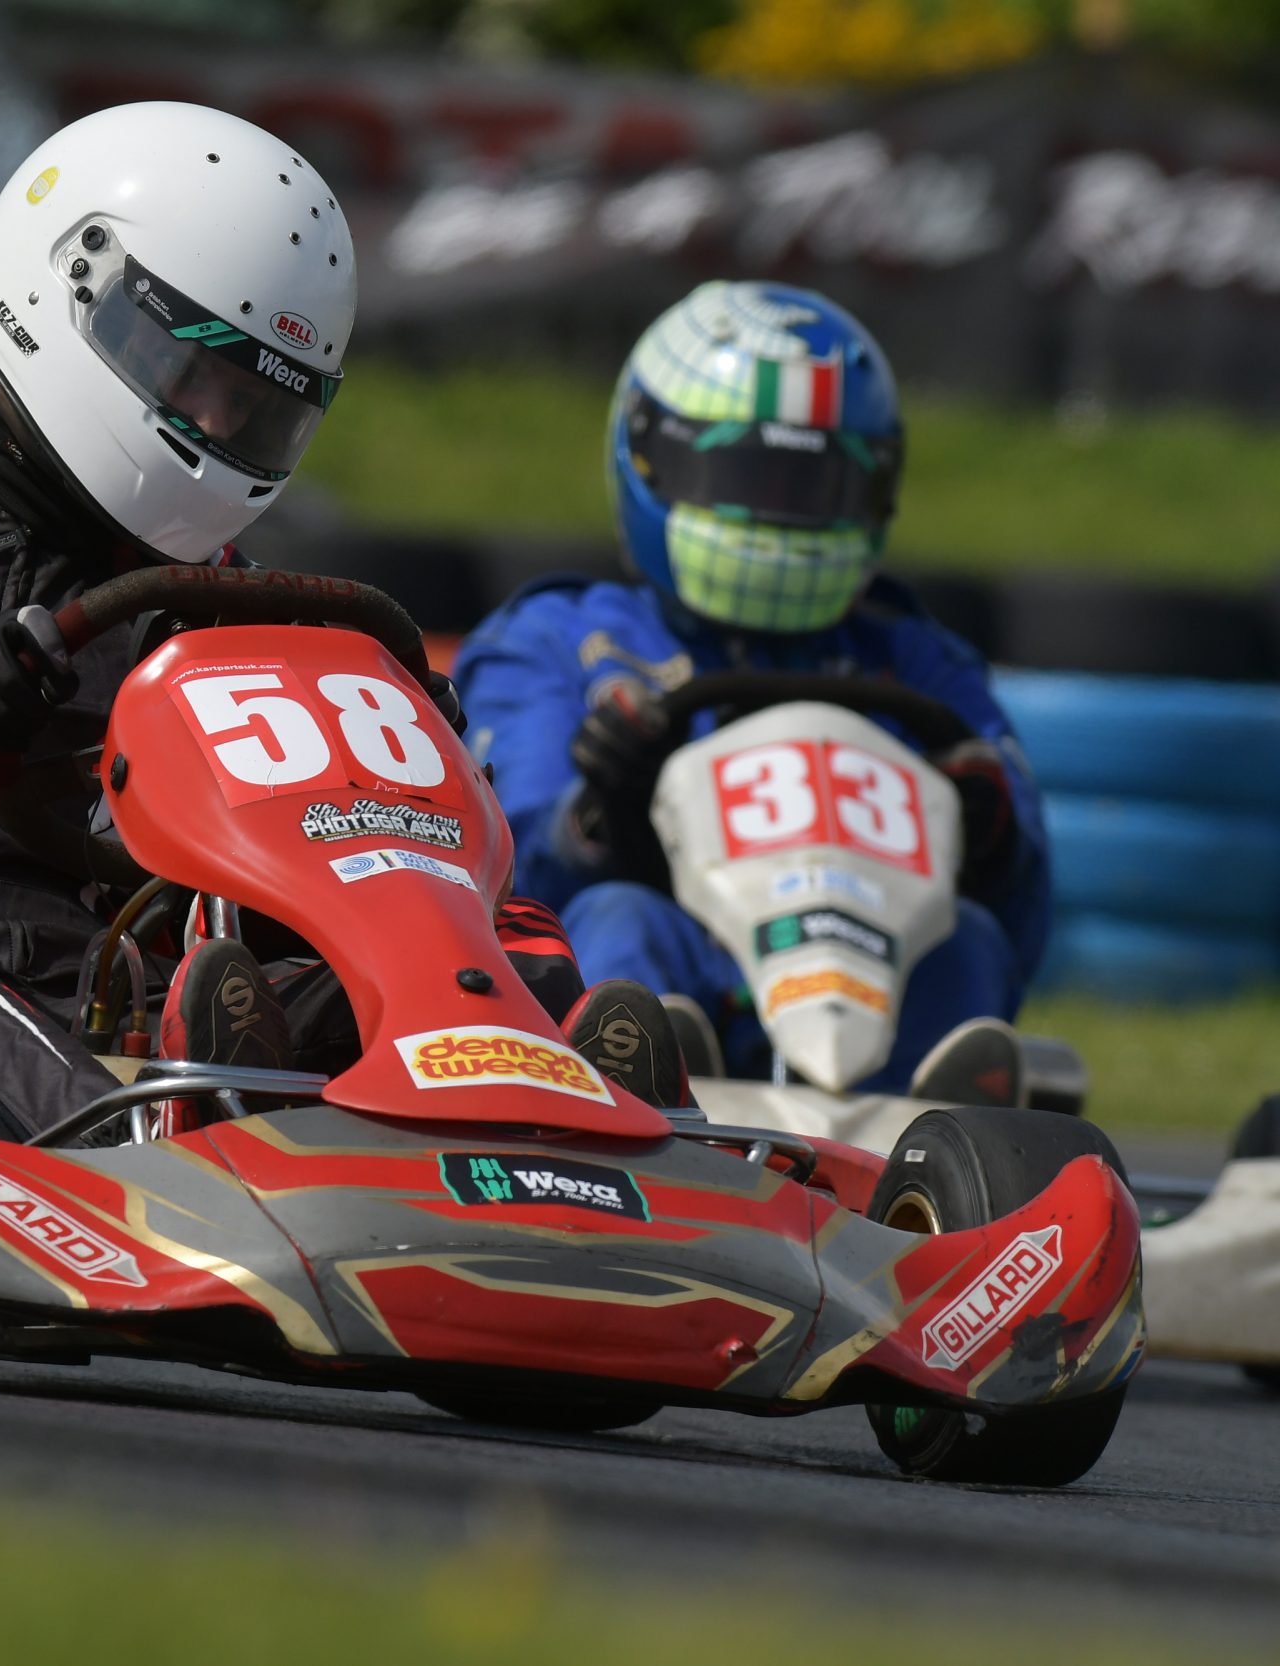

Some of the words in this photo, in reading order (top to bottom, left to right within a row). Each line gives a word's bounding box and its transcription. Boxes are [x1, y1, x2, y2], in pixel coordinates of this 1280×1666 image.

[277, 315, 311, 345] BELL
[256, 348, 310, 394] Wera
[171, 664, 283, 685] www.kartpartsuk.com
[180, 673, 445, 787] 58
[721, 747, 919, 856] 33
[301, 814, 463, 844] PHOTOGRAPHY
[419, 1037, 585, 1075] demon
[417, 1058, 601, 1093] tweeks
[513, 1170, 622, 1202] Wera
[937, 1247, 1043, 1354] GILLARD
